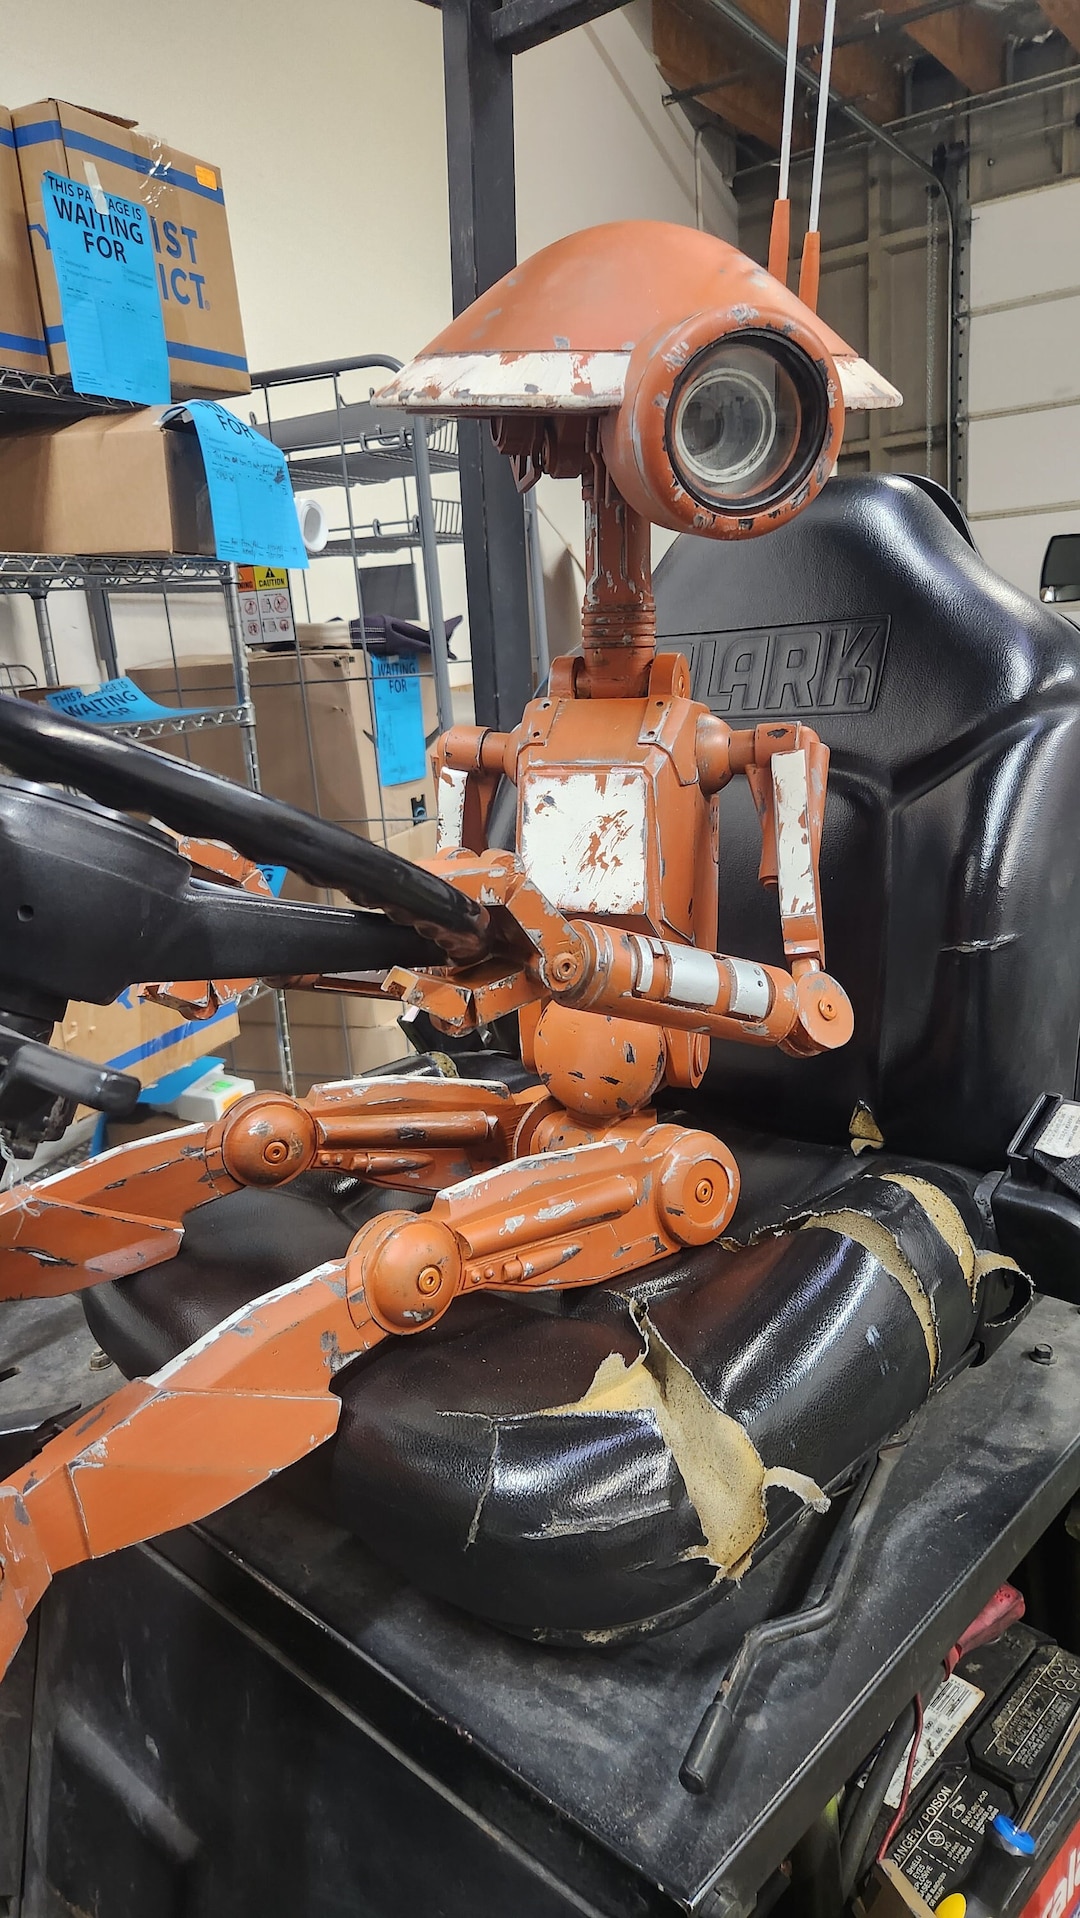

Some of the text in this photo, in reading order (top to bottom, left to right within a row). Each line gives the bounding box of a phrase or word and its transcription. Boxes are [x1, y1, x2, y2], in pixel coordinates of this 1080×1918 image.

[48, 175, 143, 221] THIS PAAGE IS
[53, 195, 144, 245] WAITING
[83, 231, 128, 264] FOR
[150, 215, 197, 264] IST
[216, 414, 255, 440] FOR
[258, 578, 286, 587] CAUTION
[377, 662, 416, 677] WAITING
[53, 692, 76, 706] THIS
[76, 681, 117, 700] PAGE
[388, 678, 408, 694] FOR
[62, 690, 138, 718] WAITING
[921, 1785, 952, 1822] POISON
[942, 1840, 952, 1851] NO
[905, 1854, 922, 1875] SHIELD
[912, 1863, 926, 1879] EYES
[912, 1864, 934, 1891] XPLOSIVE
